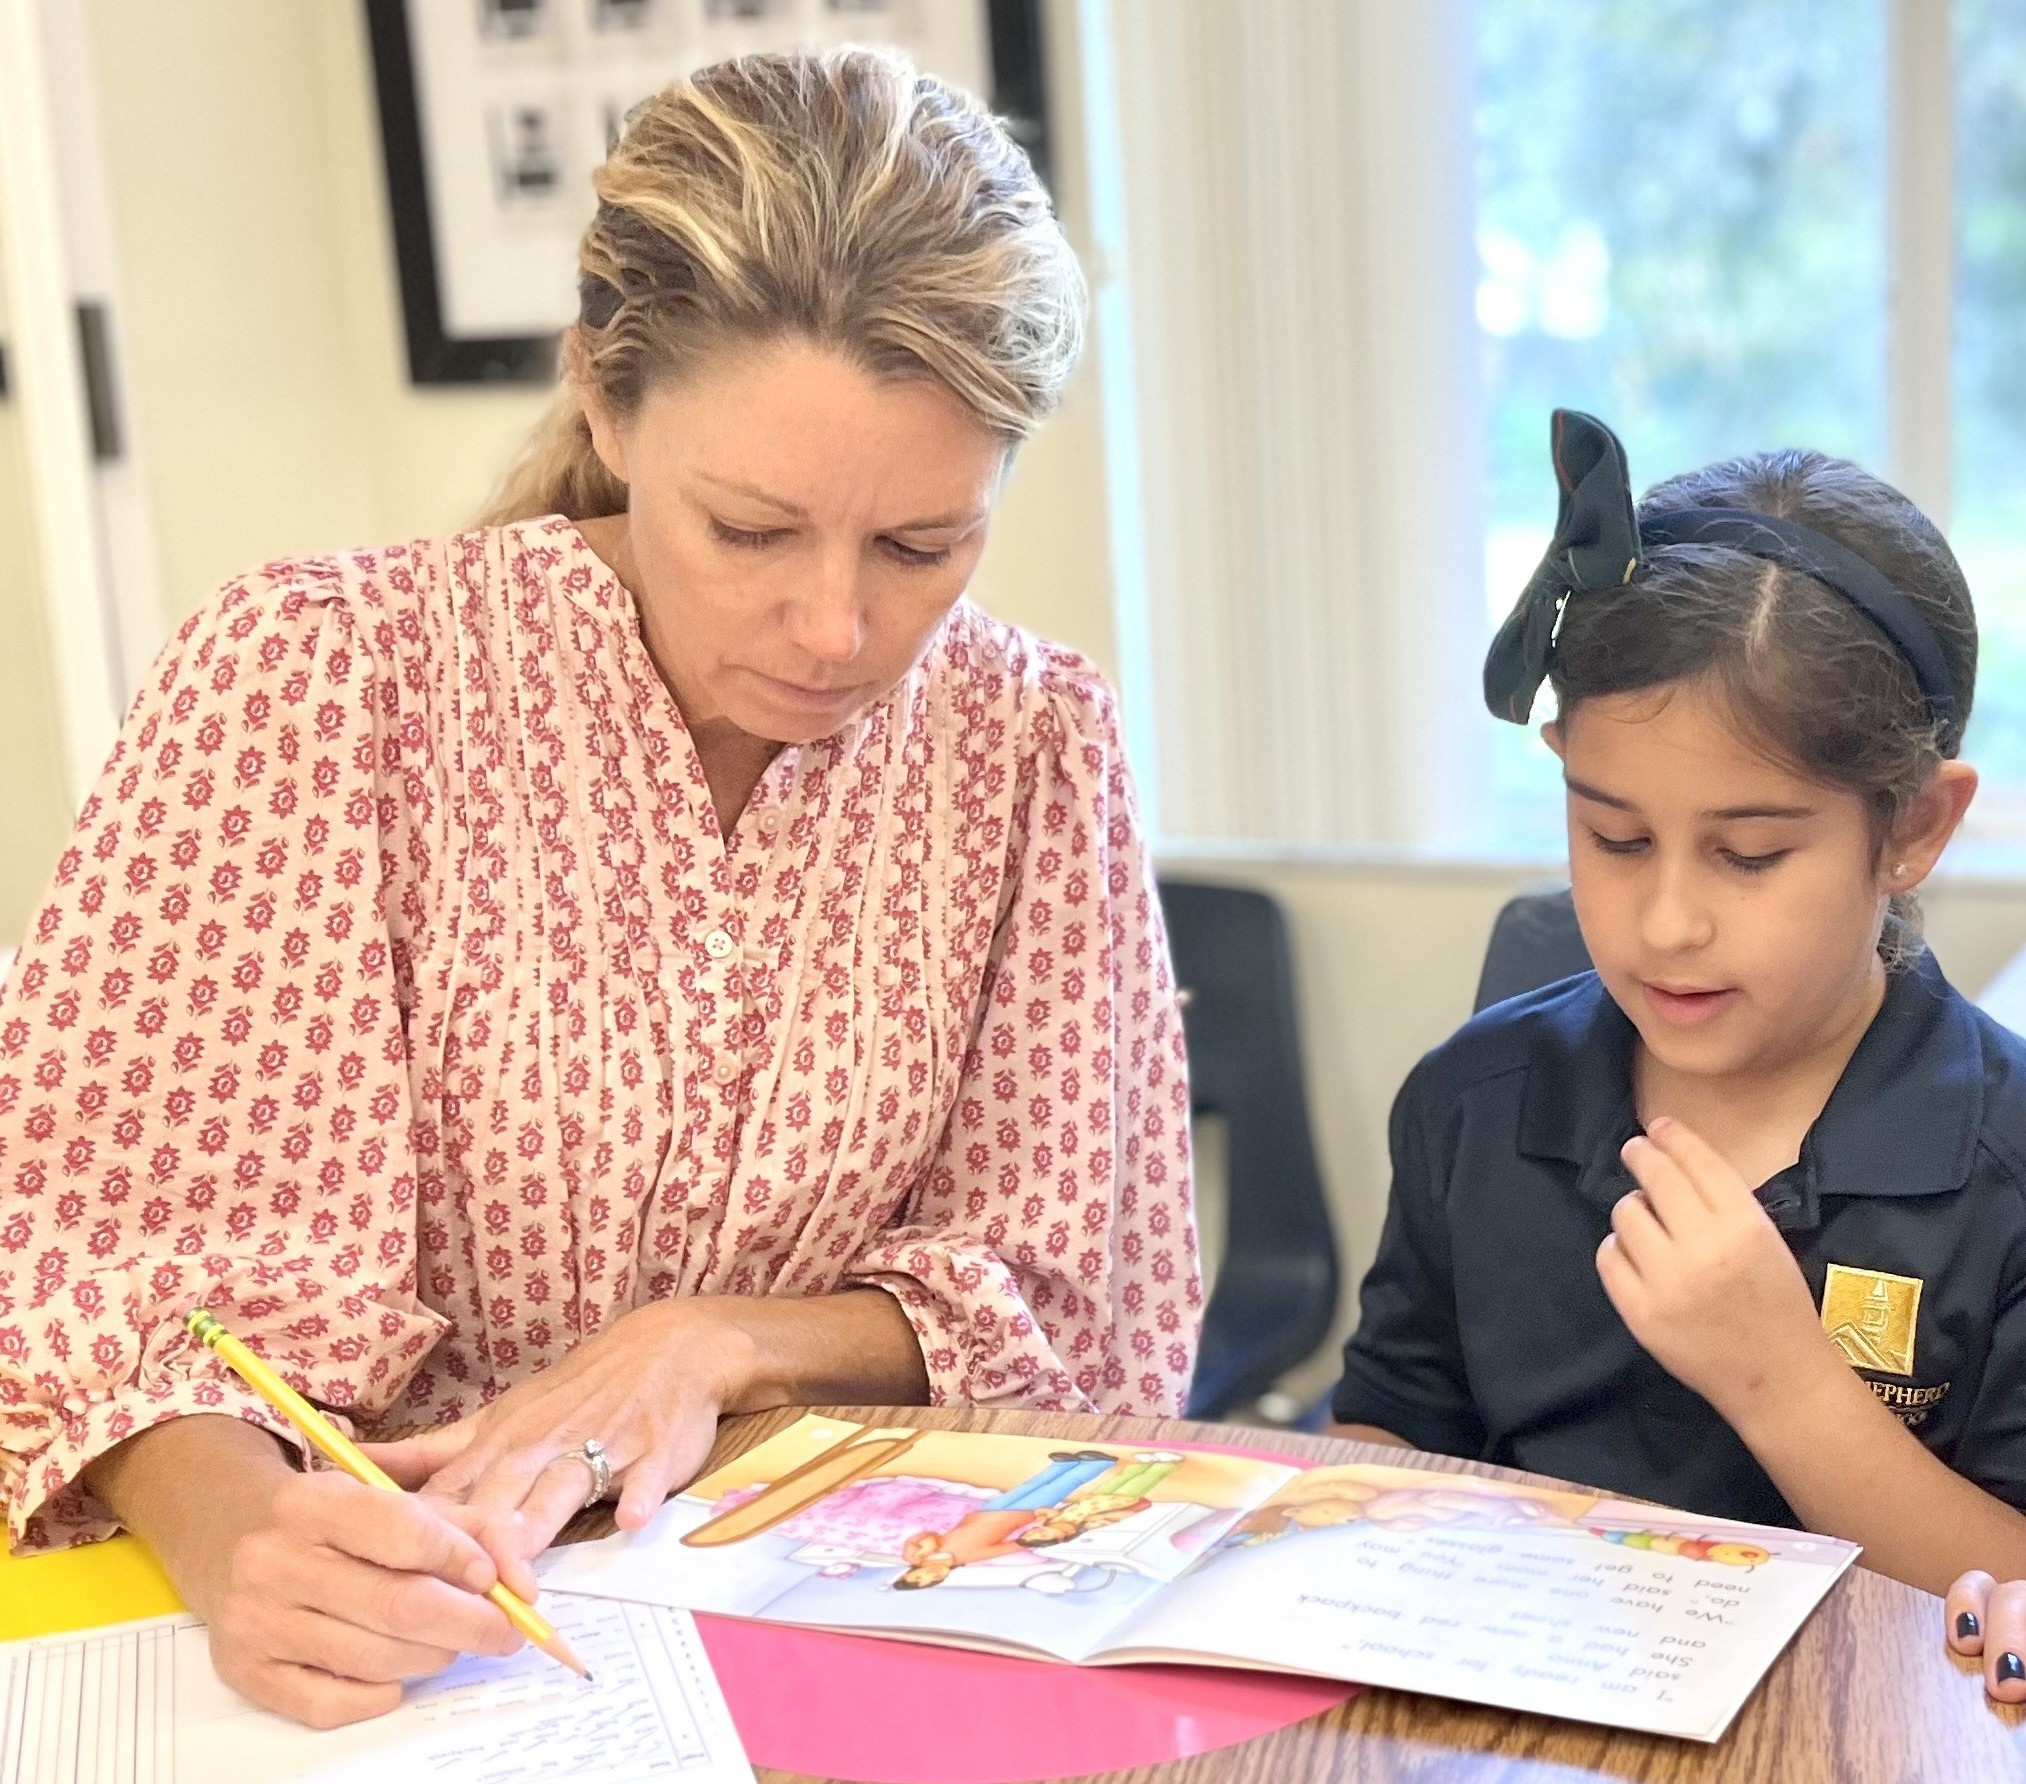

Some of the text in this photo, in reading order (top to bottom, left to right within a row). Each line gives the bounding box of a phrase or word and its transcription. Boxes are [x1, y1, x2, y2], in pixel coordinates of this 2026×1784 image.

[1355, 1541, 1400, 1555] may
[1520, 1553, 1574, 1567] some
[1397, 1562, 1452, 1581] thing
[1593, 1564, 1633, 1575] get
[1472, 1576, 1530, 1590] more
[1568, 1575, 1605, 1588] her
[1694, 1580, 1750, 1594] need
[1549, 1588, 1590, 1600] one
[1622, 1583, 1671, 1597] said
[1296, 1594, 1401, 1621] backpack
[1609, 1596, 1664, 1613] have
[1417, 1615, 1461, 1628] red
[1480, 1625, 1528, 1639] new
[1591, 1625, 1640, 1639] new
[1581, 1641, 1629, 1657] had
[1659, 1635, 1706, 1649] and
[1454, 1658, 1488, 1672] for
[1650, 1652, 1694, 1667] She
[1510, 1665, 1580, 1685] ready
[1629, 1667, 1680, 1681] said
